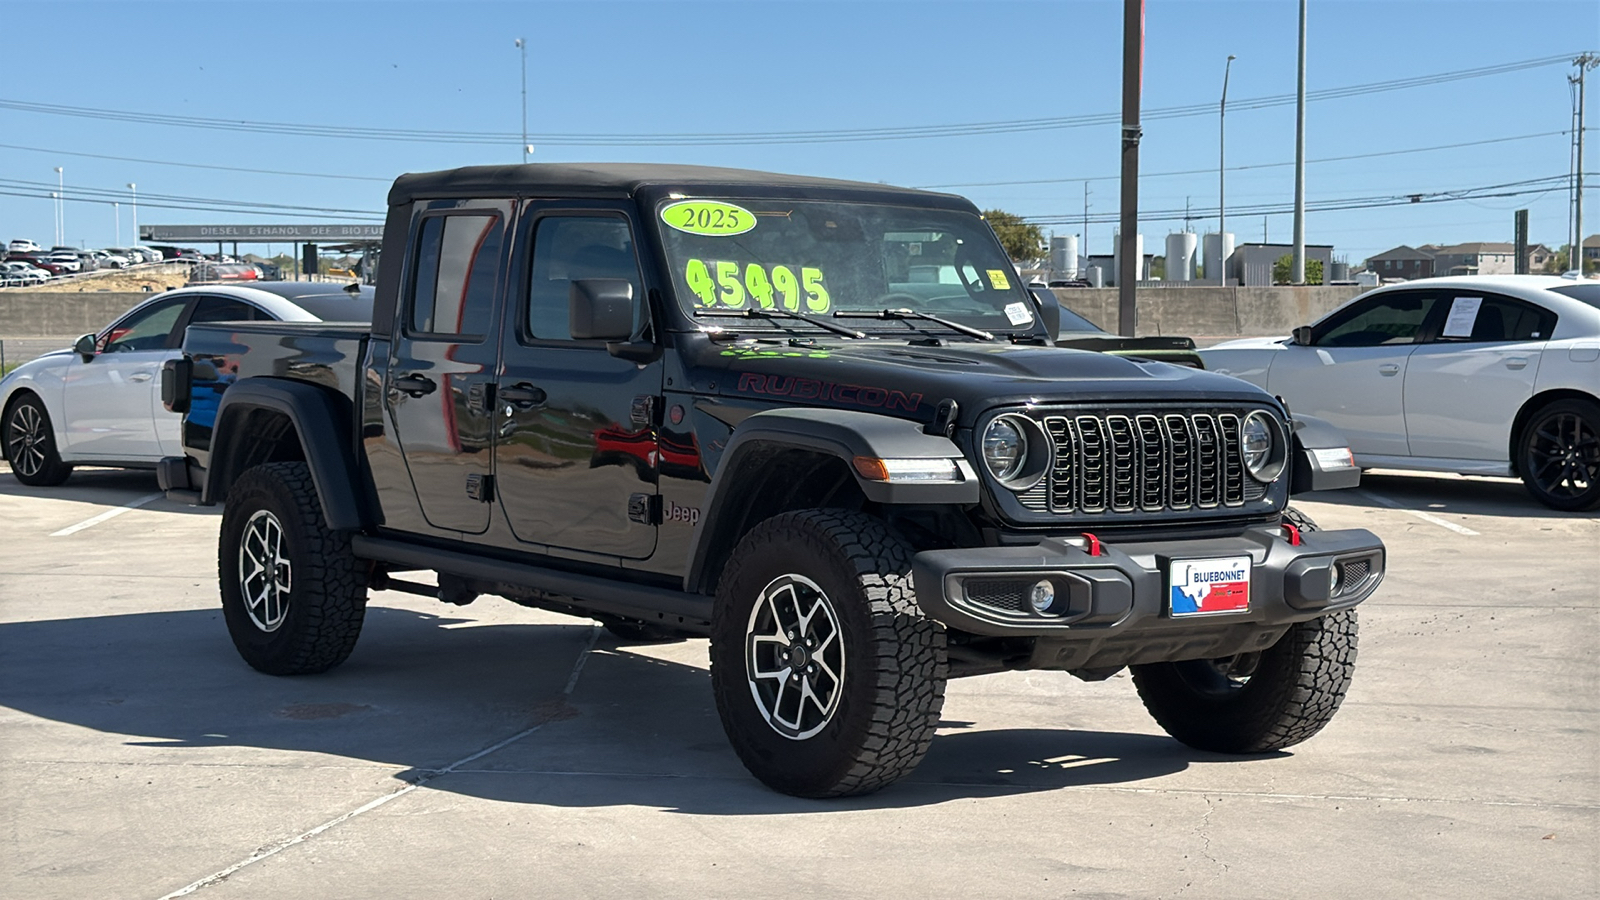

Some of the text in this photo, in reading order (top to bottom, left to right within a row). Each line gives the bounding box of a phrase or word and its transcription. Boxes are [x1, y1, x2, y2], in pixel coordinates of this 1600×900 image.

[682, 208, 740, 229] 2025
[200, 226, 384, 236] DIESEL ETHANOL DEF BIO FUE
[685, 258, 831, 314] 45495
[737, 372, 924, 412] RUBICON
[663, 500, 700, 525] Jeep
[1193, 569, 1245, 583] BLUEBONNET
